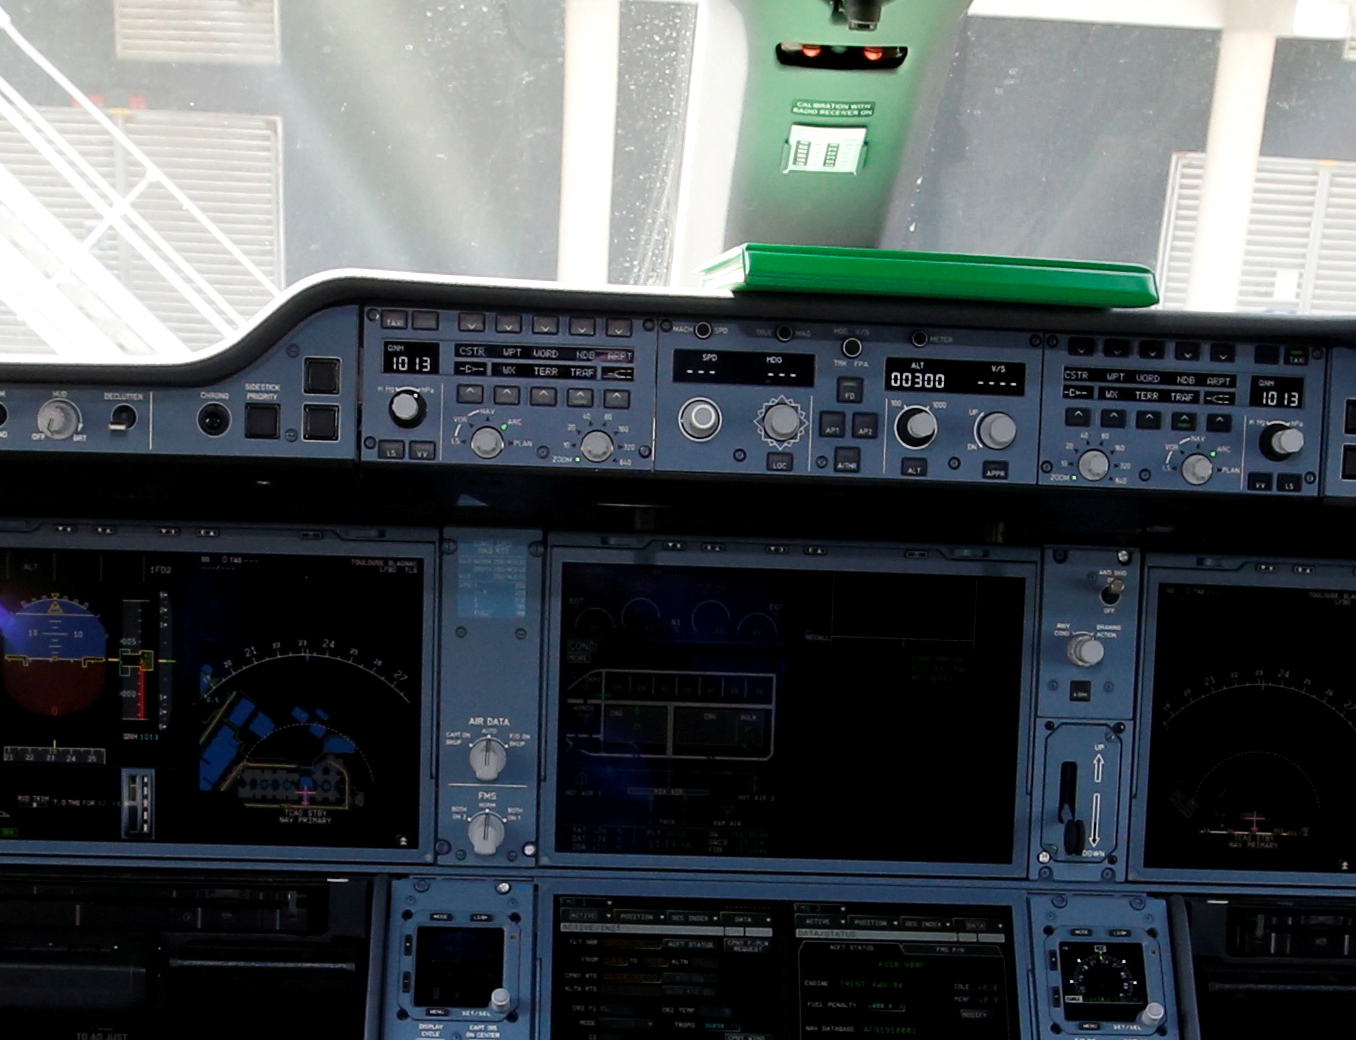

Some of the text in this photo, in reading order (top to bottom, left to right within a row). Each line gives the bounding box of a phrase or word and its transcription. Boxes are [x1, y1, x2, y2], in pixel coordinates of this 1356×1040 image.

[459, 346, 485, 357] CSTR
[503, 347, 522, 358] WPT
[576, 350, 595, 360] NDB
[607, 351, 633, 361] ARPT
[702, 353, 718, 362] SPD
[392, 356, 431, 372] 1013
[766, 356, 783, 364] HDG
[910, 361, 925, 369] ALT
[991, 364, 1006, 373] V/S
[502, 365, 595, 377] WX TERR TRAF
[891, 371, 945, 388] 00300
[1064, 370, 1089, 380] CSTR
[1106, 371, 1125, 381] WPT
[1176, 375, 1196, 385] NDB
[1206, 376, 1231, 386] ARPT
[245, 383, 281, 392] SIDESTICK
[246, 392, 279, 401] PRIORITY
[845, 391, 855, 400] FD
[1105, 390, 1194, 402] WX TERR TRAF
[1262, 391, 1299, 407] 1013
[825, 426, 840, 434] AP1
[858, 427, 873, 435] AP2
[772, 461, 787, 469] LOC
[907, 466, 921, 474] ALT
[985, 469, 1005, 477] APPR
[1221, 466, 1241, 474] PLAN
[322, 638, 336, 649] 24
[468, 717, 511, 727] AIR DATA
[477, 791, 497, 800] FMS
[1082, 849, 1105, 858] DOWN
